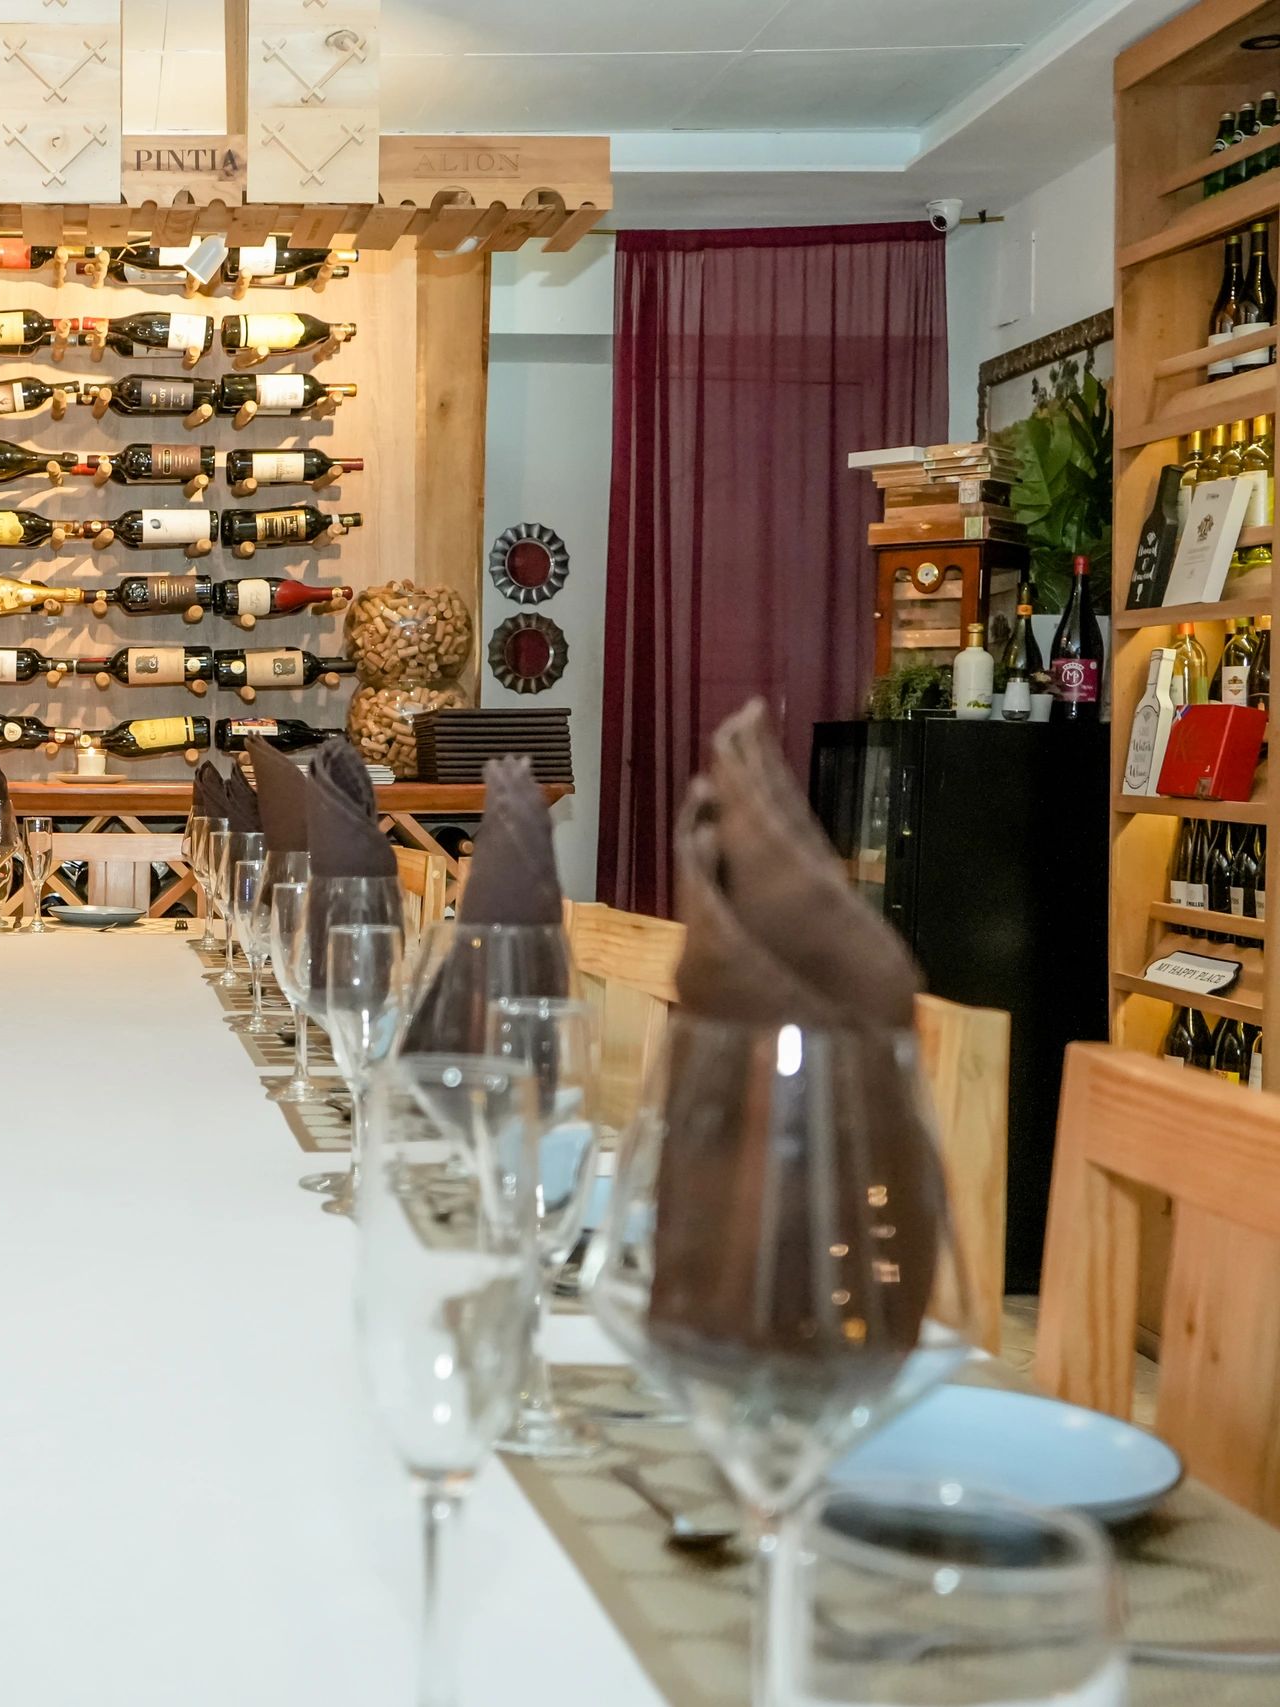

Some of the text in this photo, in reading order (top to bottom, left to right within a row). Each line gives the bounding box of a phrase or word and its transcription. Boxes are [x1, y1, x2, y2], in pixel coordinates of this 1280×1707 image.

[133, 148, 239, 172] PINTIA
[412, 152, 520, 172] ALION
[1155, 962, 1226, 985] MY HAPPY PLACE
